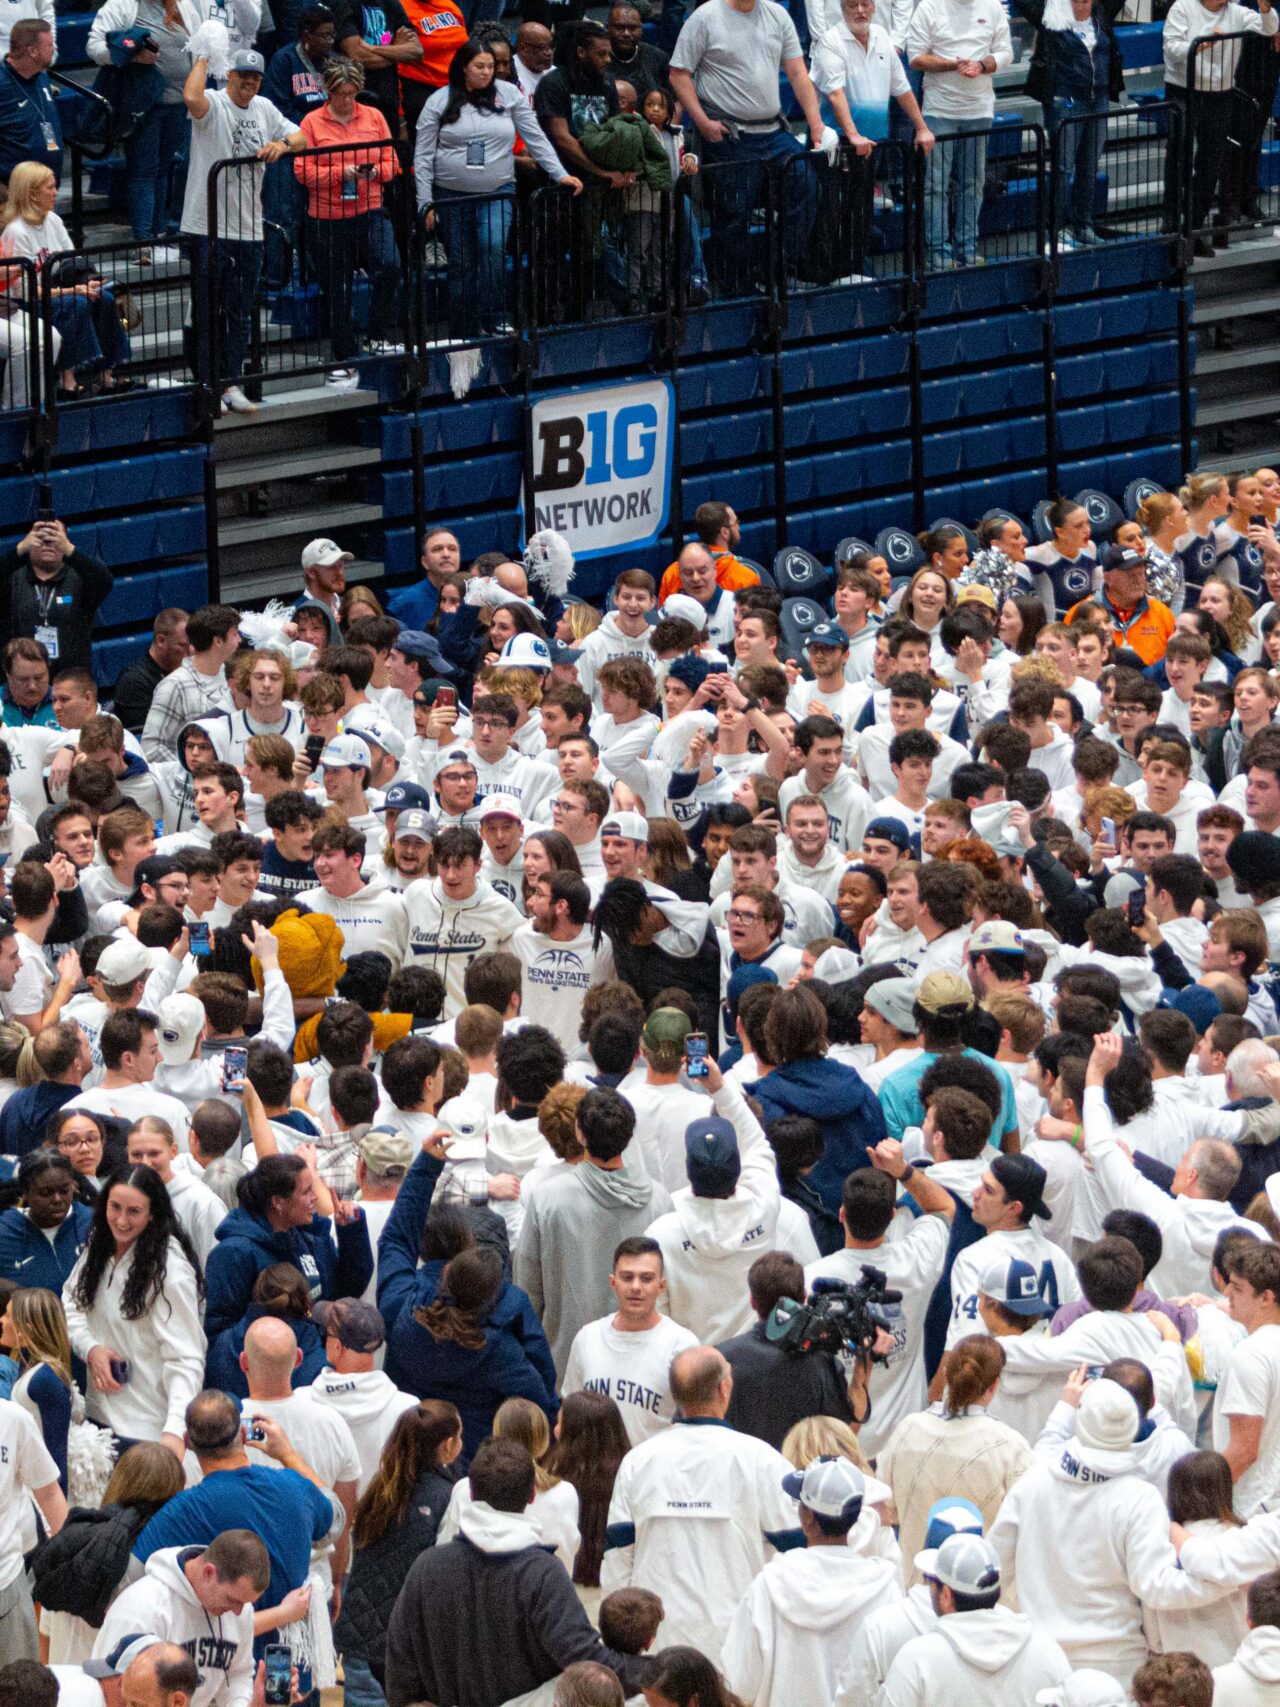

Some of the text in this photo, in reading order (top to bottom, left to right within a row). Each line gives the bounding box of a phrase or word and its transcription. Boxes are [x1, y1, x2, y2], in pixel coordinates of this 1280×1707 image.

[535, 488, 652, 532] NETWORK
[492, 785, 523, 800] VALLEY
[407, 812, 424, 829] S
[259, 873, 321, 890] ENN STATE
[336, 916, 383, 928] ampion
[411, 926, 482, 945] Penn State
[528, 966, 591, 983] PENN STATE
[742, 1224, 766, 1244] ATE
[954, 1293, 979, 1320] 14
[616, 1379, 662, 1414] STATE
[688, 1501, 712, 1509] STATE
